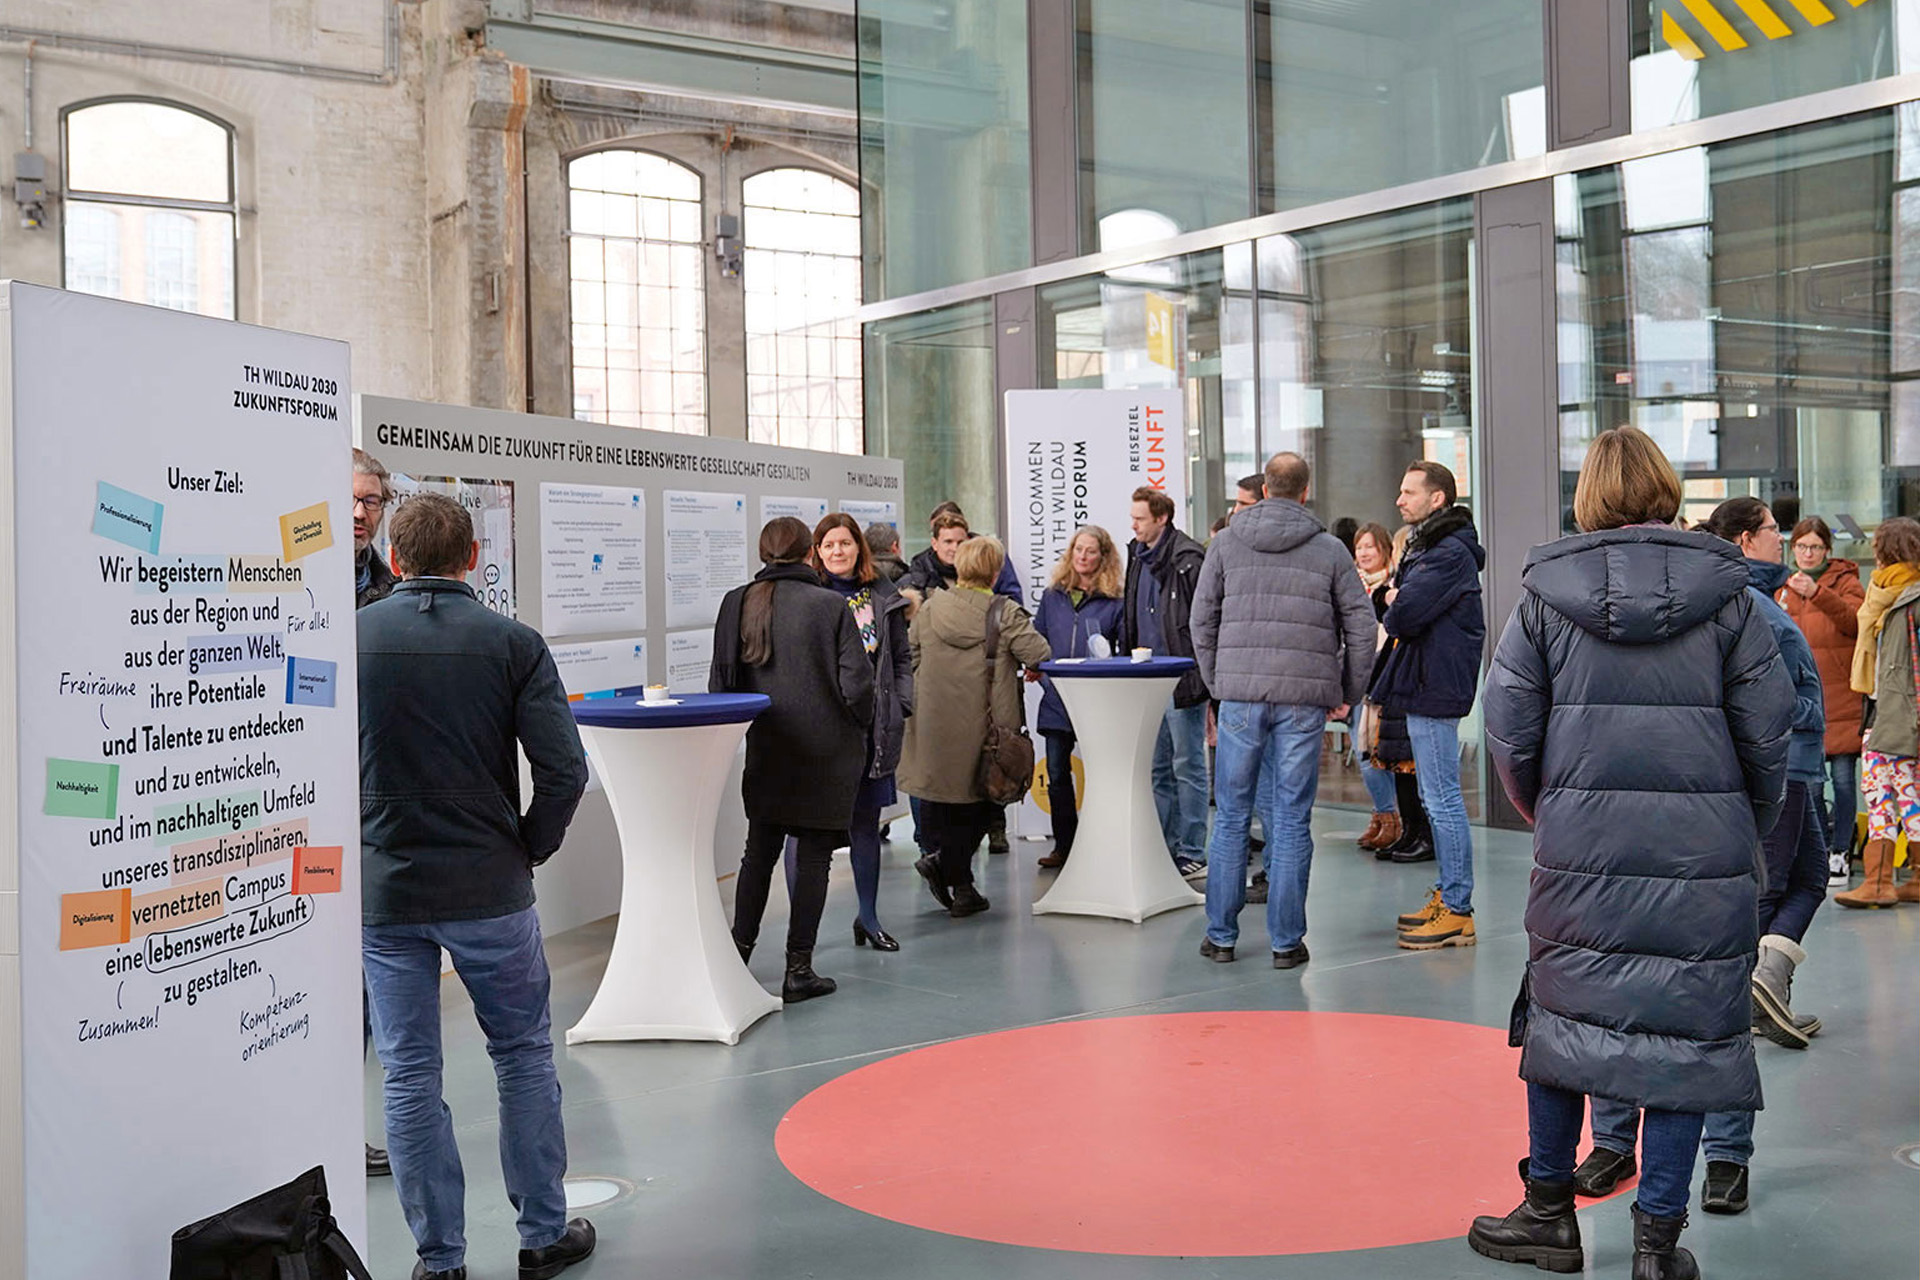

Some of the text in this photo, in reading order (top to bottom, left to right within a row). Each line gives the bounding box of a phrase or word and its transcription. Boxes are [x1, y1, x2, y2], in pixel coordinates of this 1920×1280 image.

[243, 365, 338, 396] TH WILDAU 2030
[233, 390, 338, 421] ZUKUNFTSFORUM
[377, 423, 811, 482] GEMEINSAM DIE ZUKUNFT FÜR EINE LEBENSWERTE GESELLSCHAFT GESTALTEN
[1129, 405, 1139, 472] REISEZIEL
[1146, 406, 1166, 490] KUNFT
[168, 466, 244, 494] Unser Ziel:
[847, 472, 898, 489] TH WILDAU 2030
[1050, 441, 1066, 514] WILDAU
[1073, 441, 1088, 530] TSFORUM
[1028, 441, 1045, 570] WILLKOMMEN
[1052, 519, 1066, 542] TH
[100, 556, 302, 593] Wir begeistern Menschen
[130, 596, 279, 632] aus der Region und
[287, 611, 330, 634] Für alle!
[124, 636, 286, 673] aus der ganzen Welt,
[59, 672, 136, 697] Freiräume
[150, 675, 266, 709] ihre Potentiale
[102, 711, 304, 757] und Talente zu entdecken
[56, 780, 99, 795] Nachhaltigkeit
[135, 752, 281, 796] und zu entwickeln,
[89, 782, 315, 847] und im nachhaltigen Umfeld
[102, 827, 308, 889] unseres transdisziplinären,
[73, 913, 114, 925] Digitalisierung
[132, 872, 286, 925] vernetzten Campus
[105, 898, 307, 976] eine lebenswerte Zukunft
[163, 957, 262, 1006] zu gestalten.
[78, 1005, 160, 1042] Zusammen!
[240, 992, 308, 1034] Kompetenz-
[242, 1013, 310, 1062] orientierung
